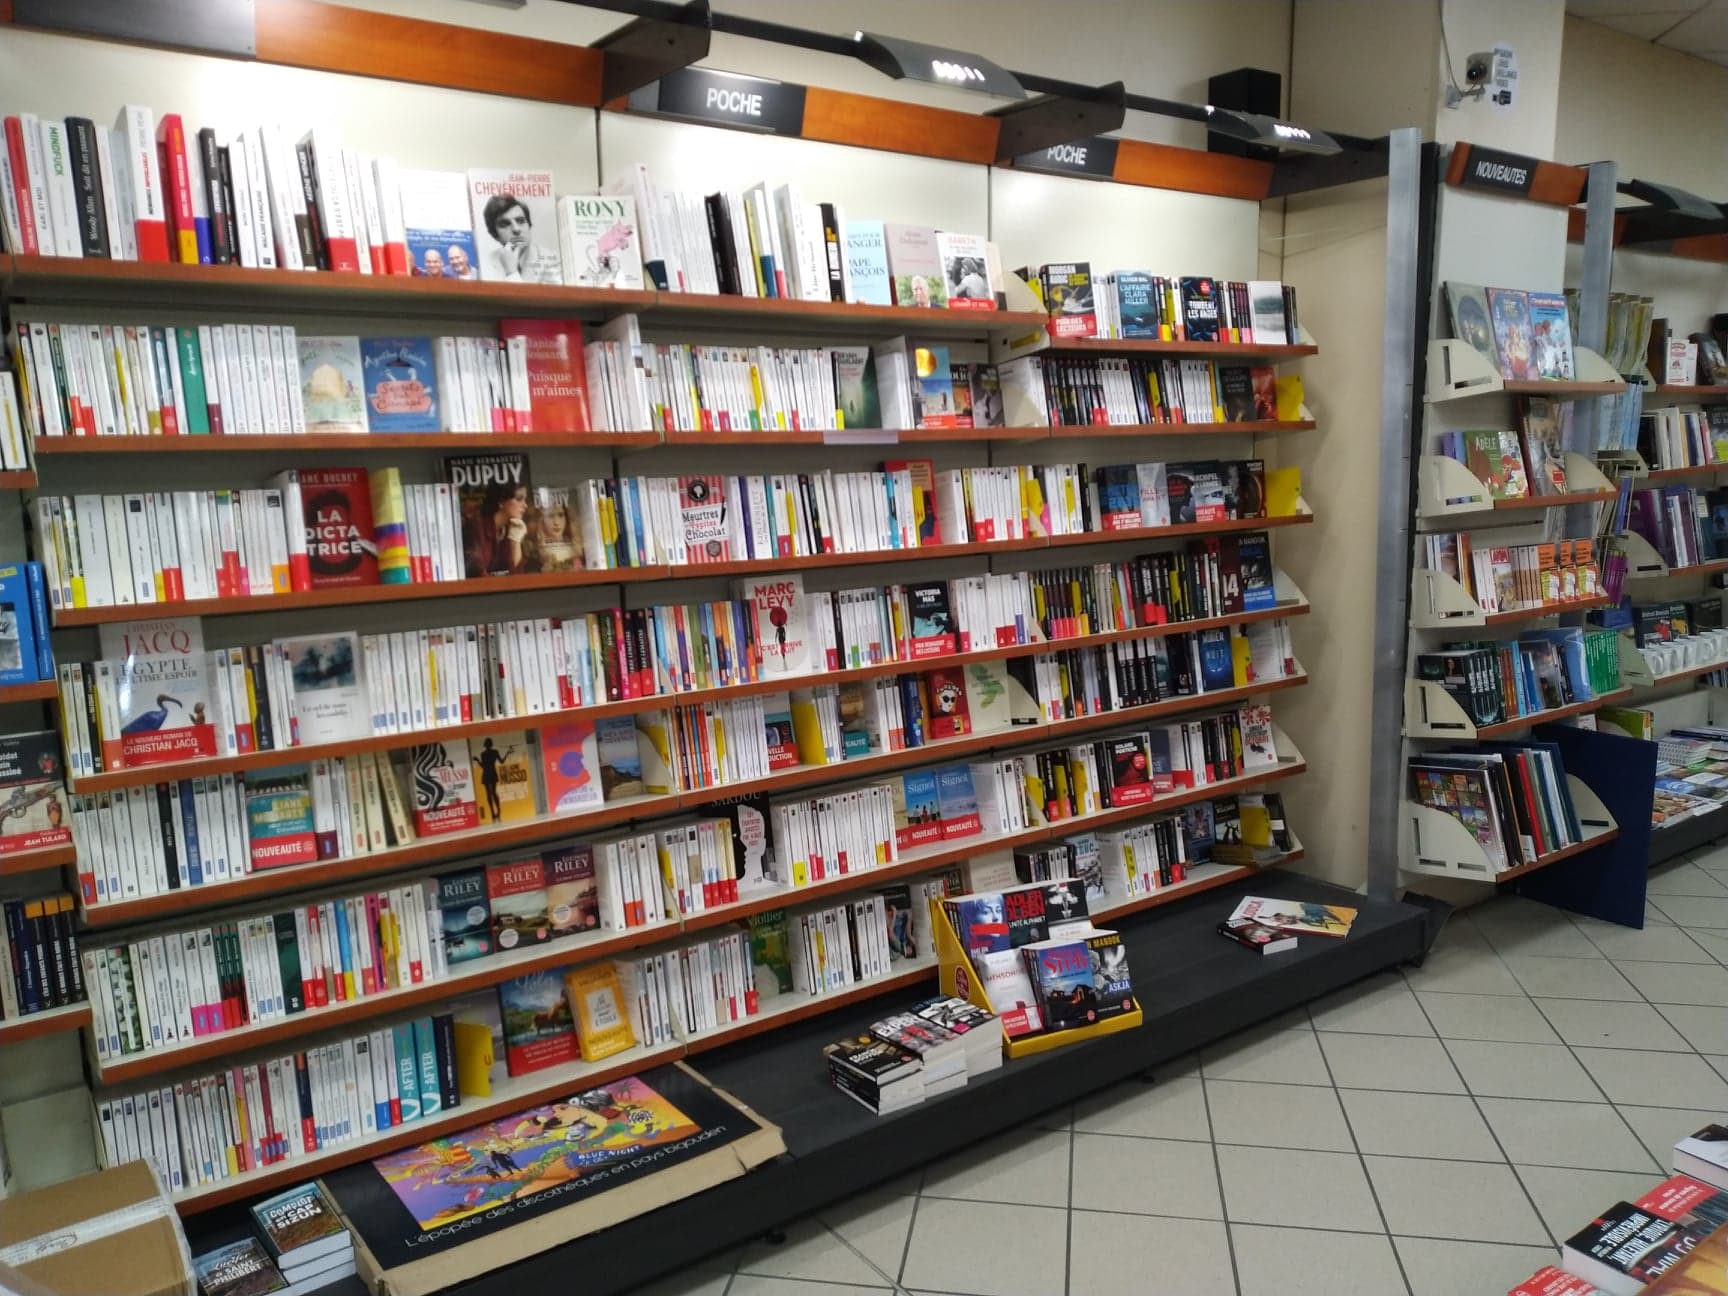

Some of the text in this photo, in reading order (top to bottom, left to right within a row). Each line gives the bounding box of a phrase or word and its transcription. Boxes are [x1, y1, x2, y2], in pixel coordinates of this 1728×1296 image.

[706, 87, 762, 116] POCHE
[1047, 144, 1087, 165] POCHE
[1476, 161, 1527, 185] NOUVEAUTES
[573, 199, 627, 217] RONY
[451, 463, 523, 487] DUPUY
[317, 510, 342, 523] LA
[682, 508, 719, 525] Meurtres
[305, 525, 360, 540] DICTA
[686, 525, 727, 541] Chocolat
[308, 541, 363, 556] TRICE
[754, 581, 796, 597] MARC
[914, 588, 942, 596] VICTORIA
[759, 595, 795, 611] LEVY
[121, 629, 191, 660] JACQ
[123, 737, 199, 756] CHRISTIAN JACQ
[767, 745, 785, 755] VELLE
[422, 806, 466, 822] NOUVEAUTÉ
[911, 827, 938, 840] NOUVEAUTÉ
[946, 820, 974, 834] NOUVEAUTÉ
[24, 837, 40, 847] JEAN
[252, 843, 303, 859] NOUVEAUTÉ
[554, 858, 589, 873] RILEY
[503, 869, 540, 885] RILEY
[443, 881, 481, 897] RILEY
[400, 1057, 414, 1091] AFTER
[421, 1050, 436, 1084] AFTER
[485, 1203, 515, 1220] des
[610, 1163, 631, 1177] en
[630, 1149, 664, 1173] pays
[664, 1124, 728, 1159] bigouden
[269, 1196, 312, 1219] COMPLOT
[288, 1203, 314, 1220] CAP
[276, 1207, 322, 1230] SIZUN
